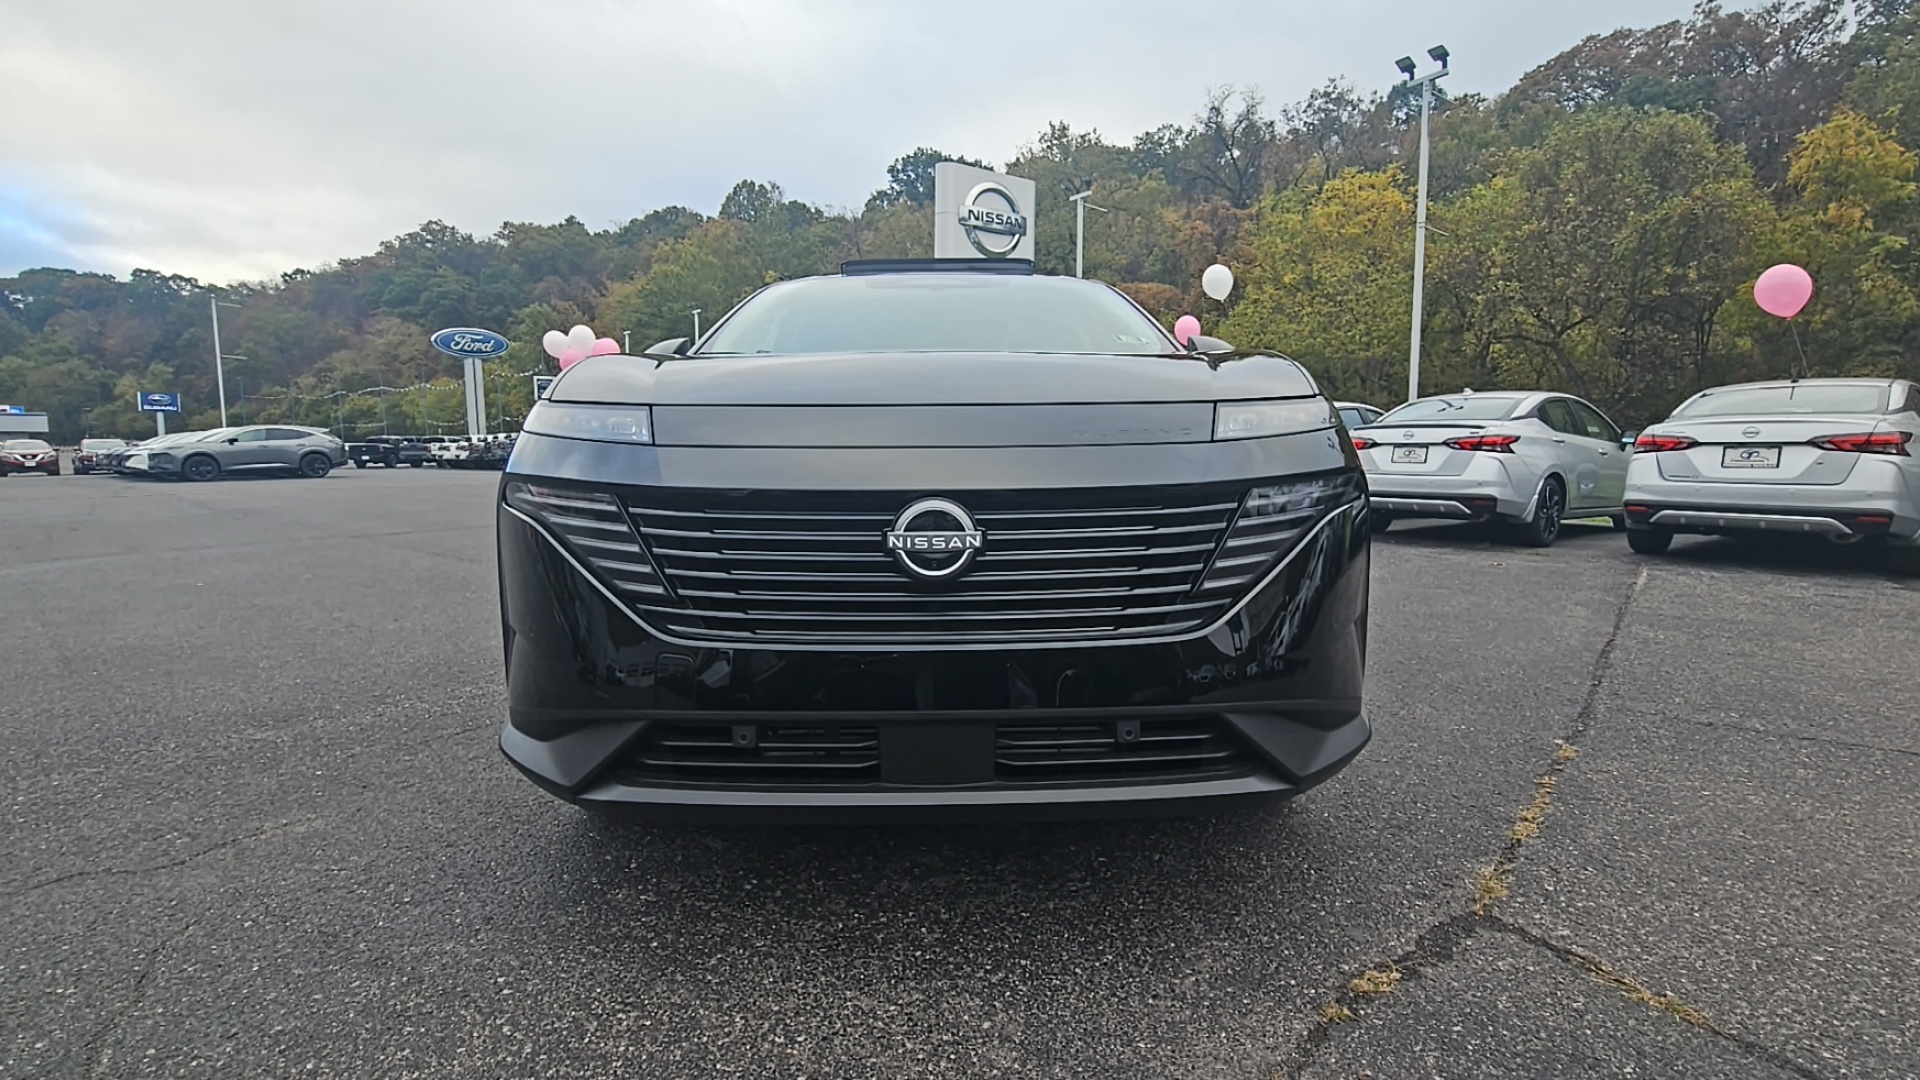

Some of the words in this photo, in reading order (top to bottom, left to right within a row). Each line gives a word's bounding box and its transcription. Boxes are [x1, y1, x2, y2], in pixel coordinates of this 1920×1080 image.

[968, 209, 1023, 230] NISSAN
[450, 333, 495, 352] Ford
[889, 535, 980, 549] NISSAN
